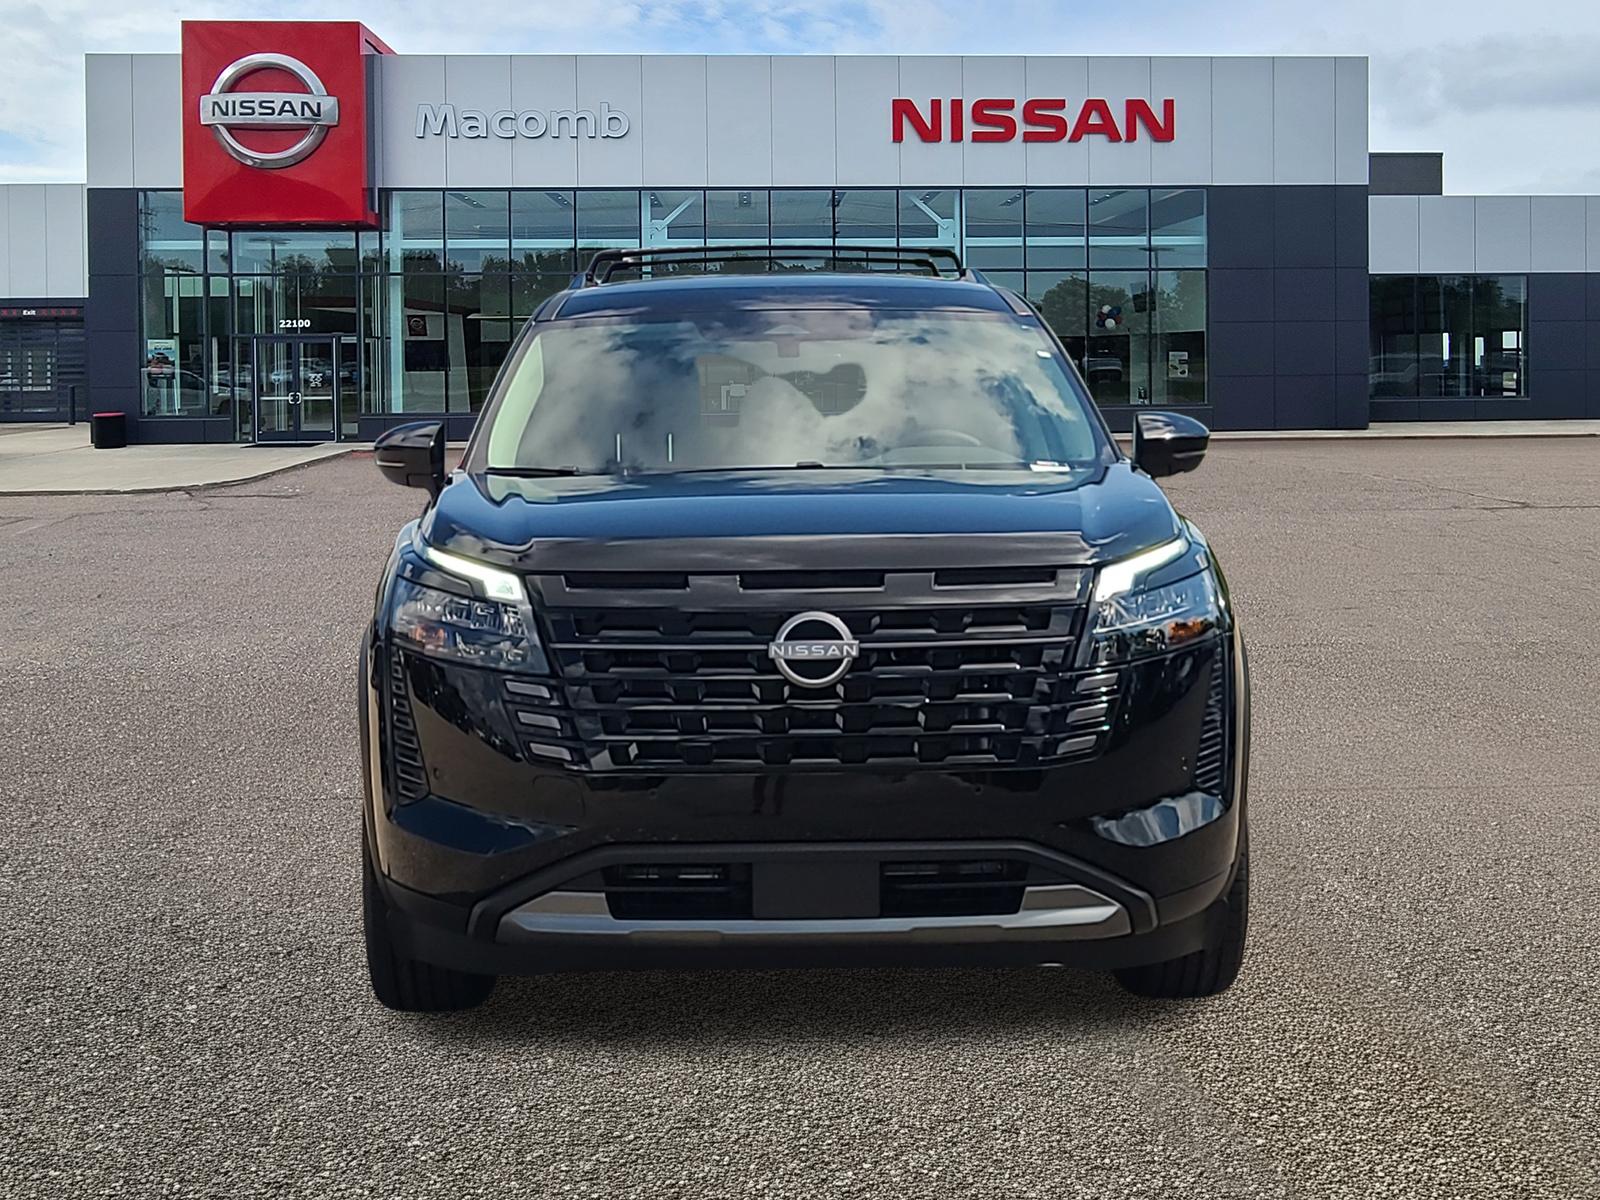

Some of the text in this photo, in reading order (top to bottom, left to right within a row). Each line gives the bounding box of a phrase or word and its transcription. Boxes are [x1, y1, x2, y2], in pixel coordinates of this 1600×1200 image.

[211, 100, 322, 117] NISSAN
[415, 102, 630, 139] Macomb
[892, 99, 1175, 143] NISSAN
[279, 319, 311, 328] 22100
[771, 645, 857, 656] NISSAN
